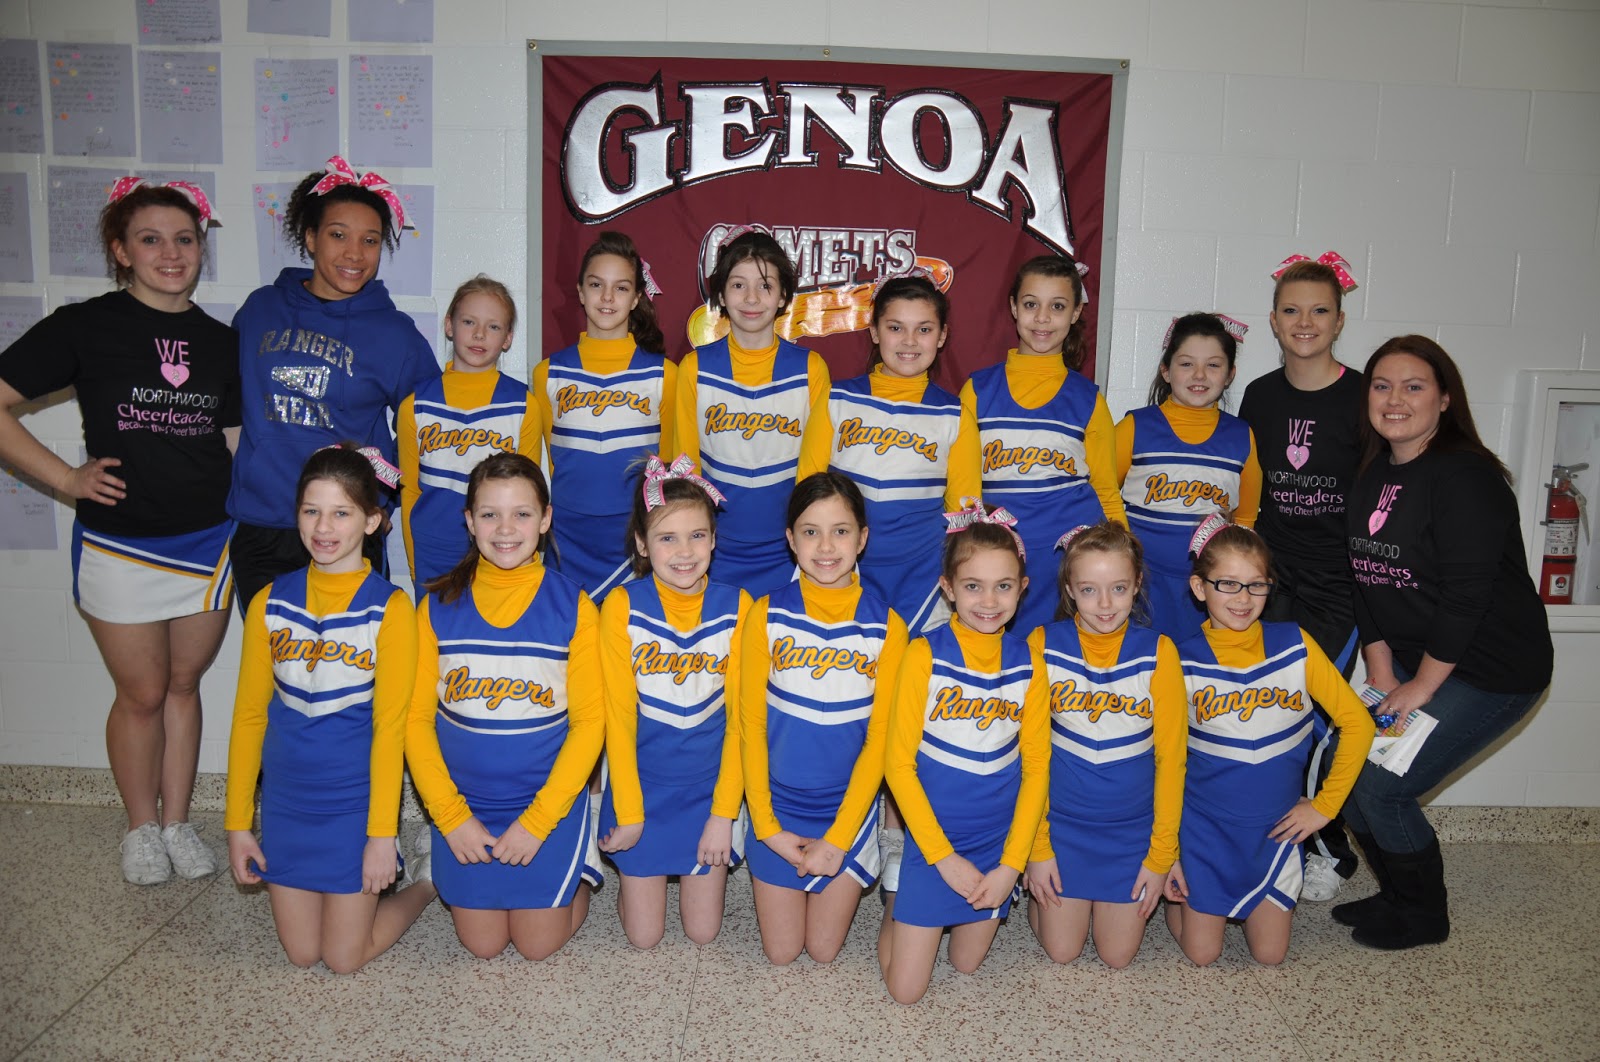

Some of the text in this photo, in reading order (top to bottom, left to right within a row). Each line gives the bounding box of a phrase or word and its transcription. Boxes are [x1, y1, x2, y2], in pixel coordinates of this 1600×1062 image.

[561, 69, 1075, 257] GENOA
[698, 223, 917, 295] CMETS
[154, 338, 190, 365] WE
[258, 328, 354, 377] RANGER
[117, 403, 215, 424] Cheerleader
[132, 387, 219, 409] NORTHWOOD
[555, 383, 652, 418] Rangers
[419, 422, 516, 456] Rangers
[705, 402, 802, 440] Rangers
[837, 417, 938, 462] Rangers
[1288, 418, 1316, 446] WE
[983, 439, 1077, 475] Rangers
[1144, 472, 1230, 510] Rangers
[1268, 470, 1337, 488] NORTHWOOD
[1269, 487, 1344, 506] eerleaders
[1376, 484, 1403, 512] WE
[1293, 505, 1313, 516] Cheer
[1327, 504, 1346, 513] Cure
[1349, 554, 1412, 580] eerleaers
[269, 627, 375, 672] Rangers
[632, 640, 730, 685] Rangers
[771, 635, 877, 680] Rangers
[444, 666, 555, 710] Rangers
[1050, 679, 1152, 723] Rangers
[1192, 685, 1305, 725] Rangers
[928, 684, 1024, 732] Rangers
